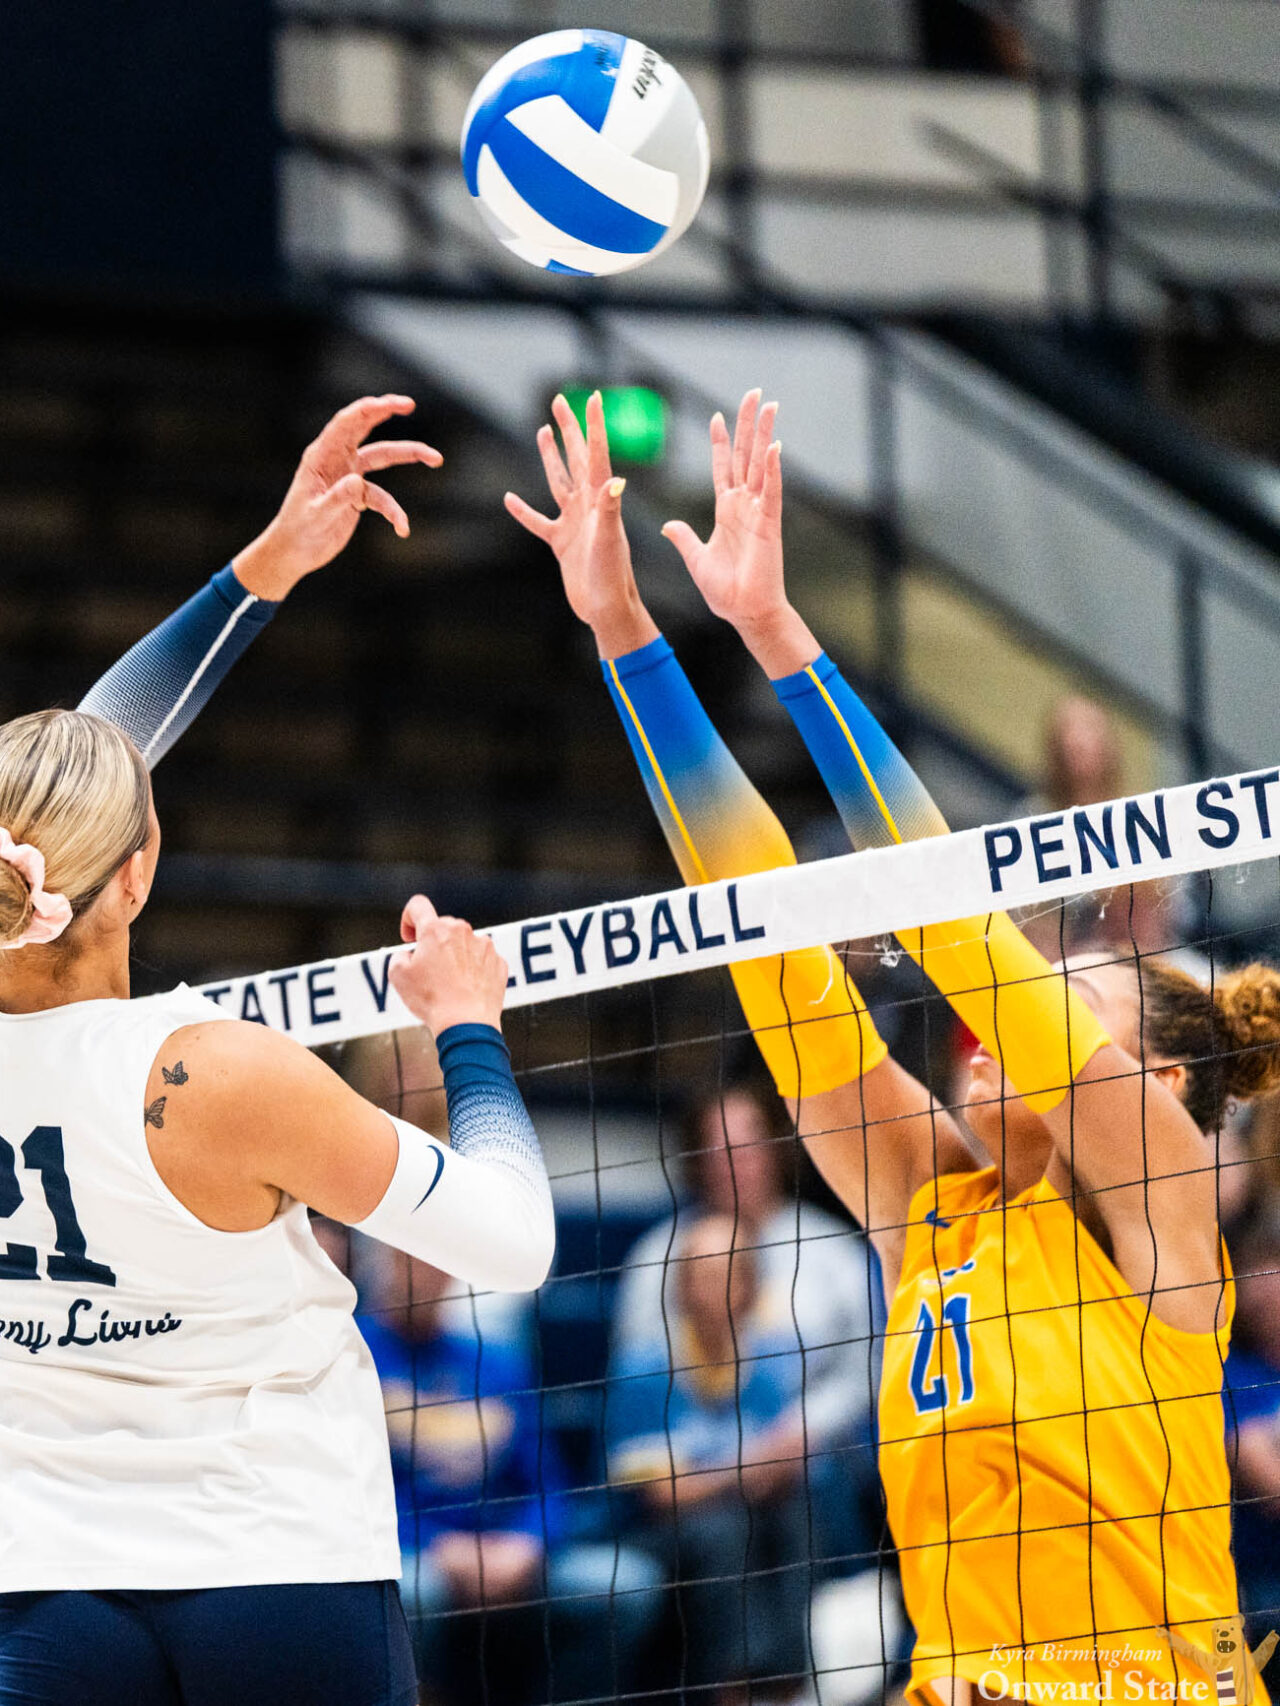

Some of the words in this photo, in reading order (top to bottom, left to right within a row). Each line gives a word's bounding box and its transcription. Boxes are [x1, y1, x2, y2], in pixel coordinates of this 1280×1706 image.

[984, 794, 1172, 893] PENN
[361, 883, 766, 1013] VEYBALL
[908, 1292, 976, 1417] 21
